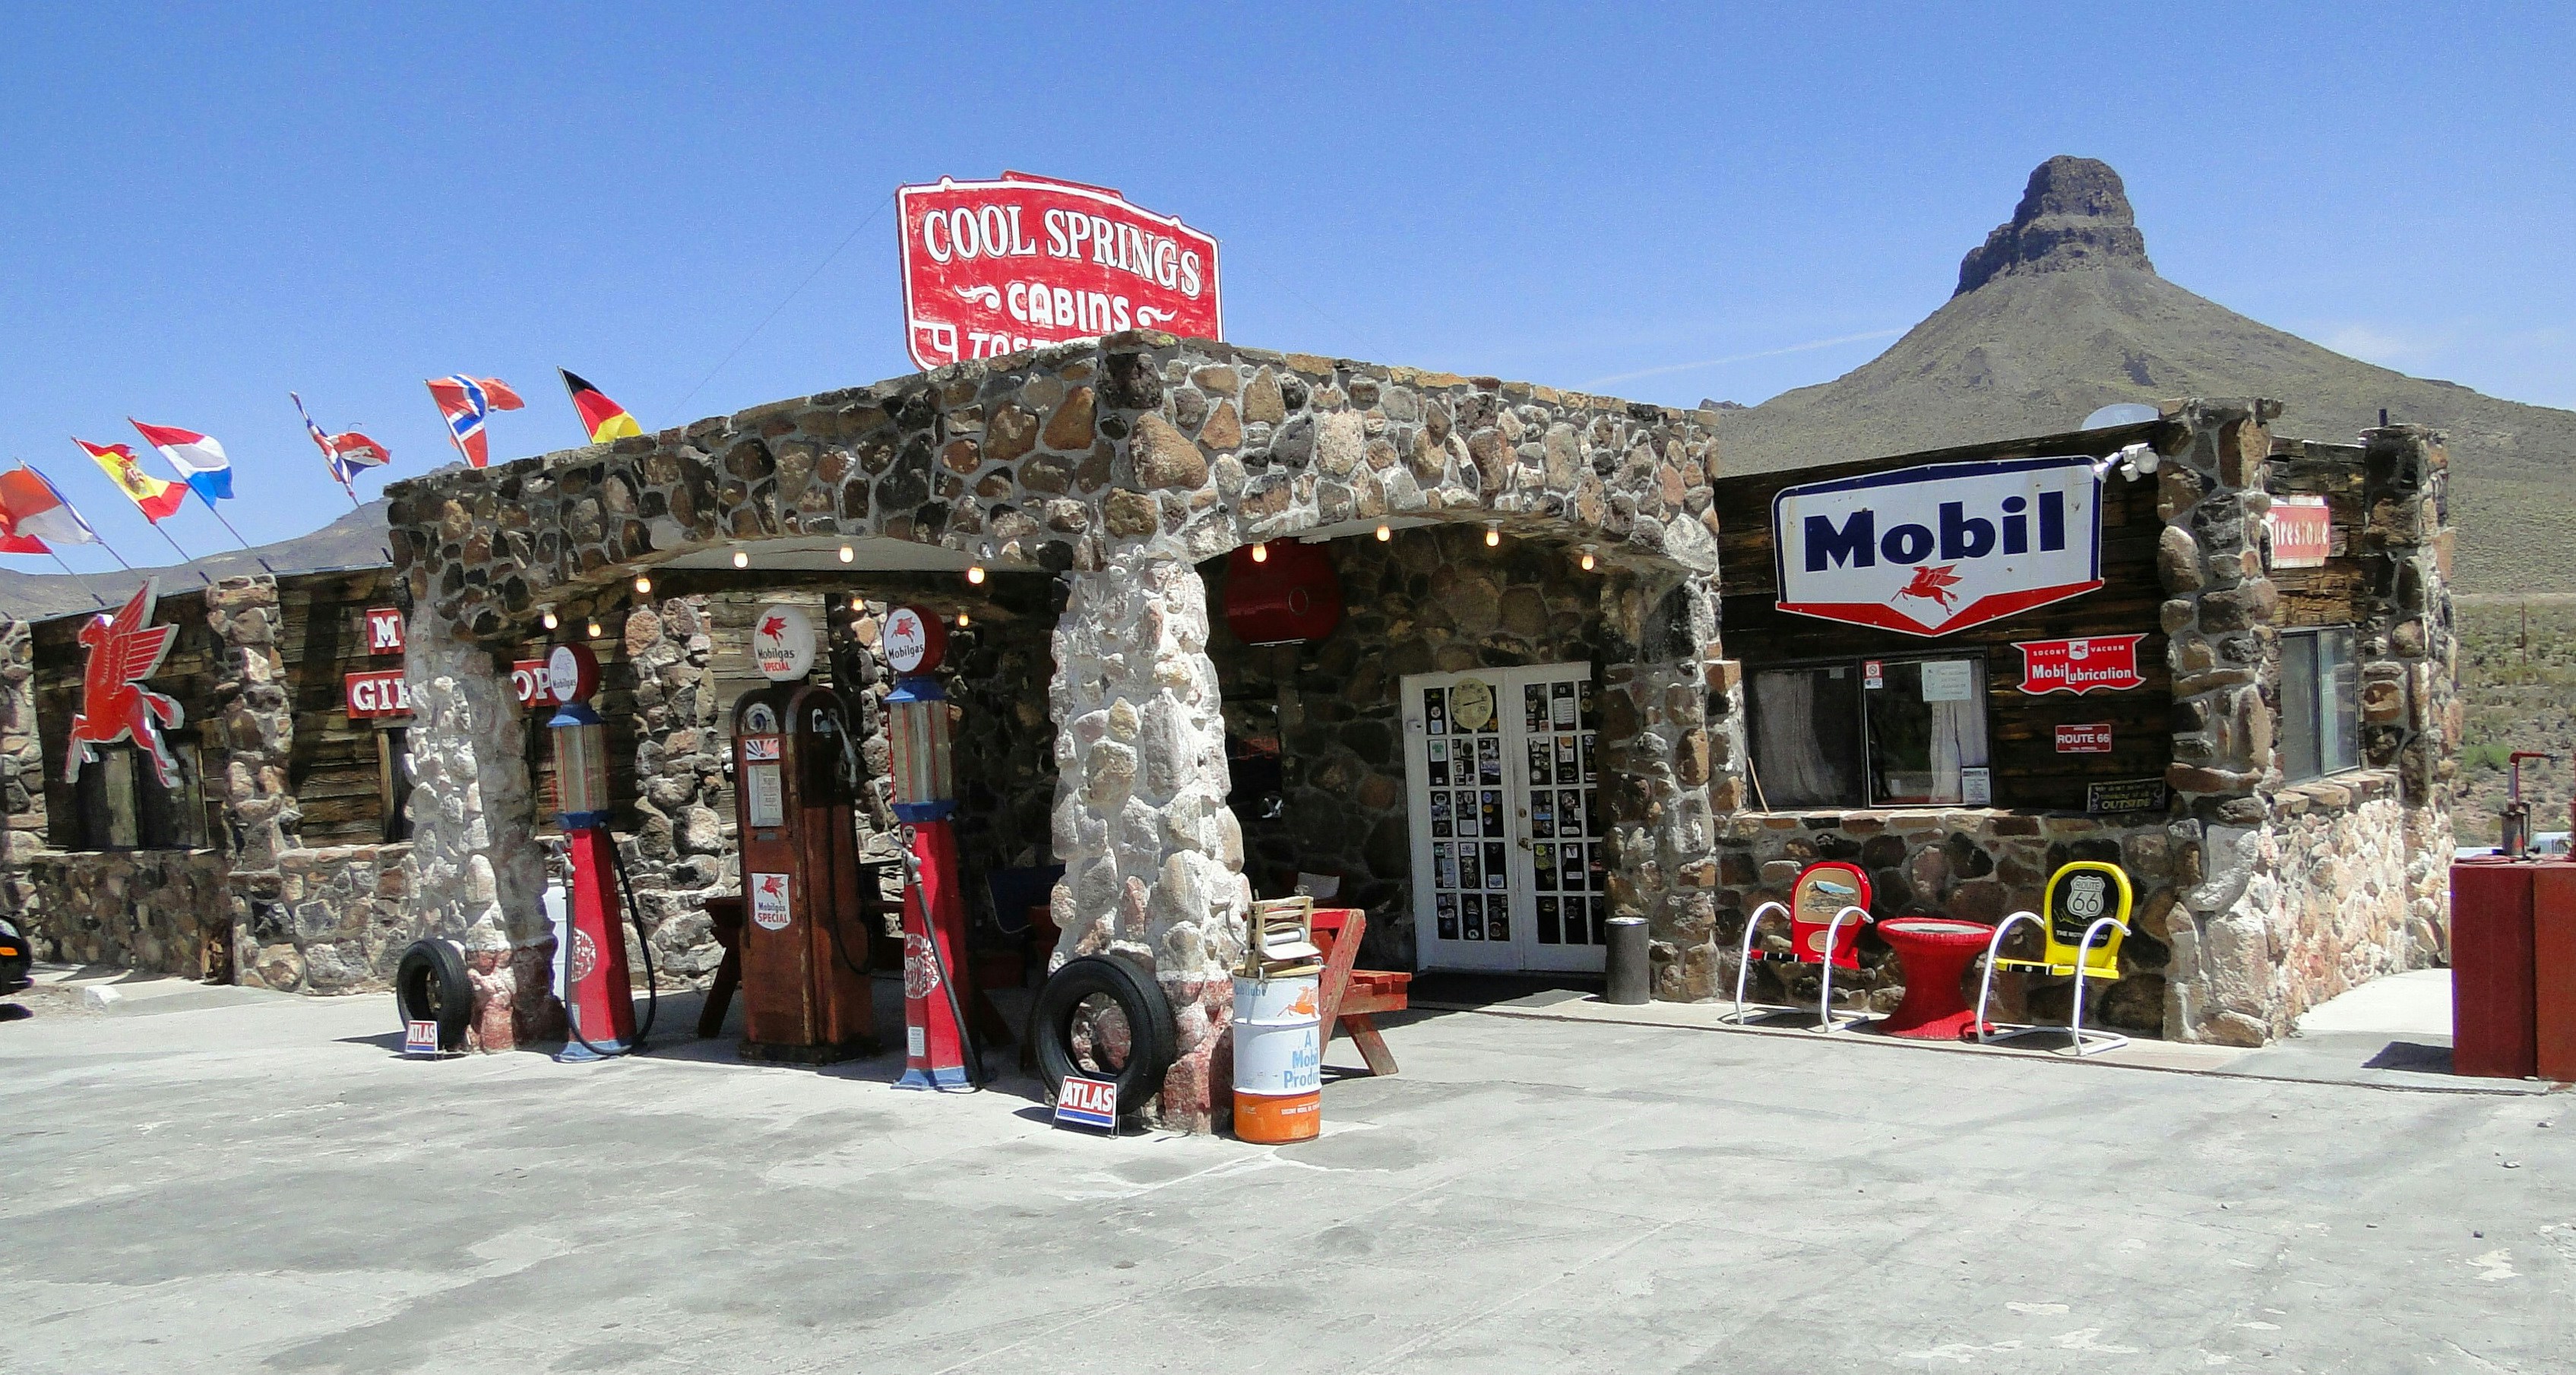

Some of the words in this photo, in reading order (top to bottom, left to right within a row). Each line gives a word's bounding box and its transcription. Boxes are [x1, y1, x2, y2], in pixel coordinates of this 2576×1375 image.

[922, 206, 1036, 262] COOL
[1044, 208, 1201, 298] SPRINGS
[1007, 283, 1131, 332] CABINS
[1803, 491, 2065, 572] Mobil
[758, 648, 795, 662] Mobilgas
[888, 644, 924, 660] Mobilgas
[764, 662, 790, 672] SPECIAL
[2032, 662, 2132, 684] MobiLubrication
[511, 667, 551, 701] OP
[2057, 734, 2095, 744] ROUTE
[2097, 733, 2110, 744] 66
[2075, 881, 2101, 890] ROUTE
[2072, 892, 2099, 912] 66
[758, 913, 788, 923] SPECIAL
[407, 1024, 435, 1043] ATLAS
[1305, 1030, 1312, 1048] A
[1060, 1081, 1114, 1112] ATLAS
